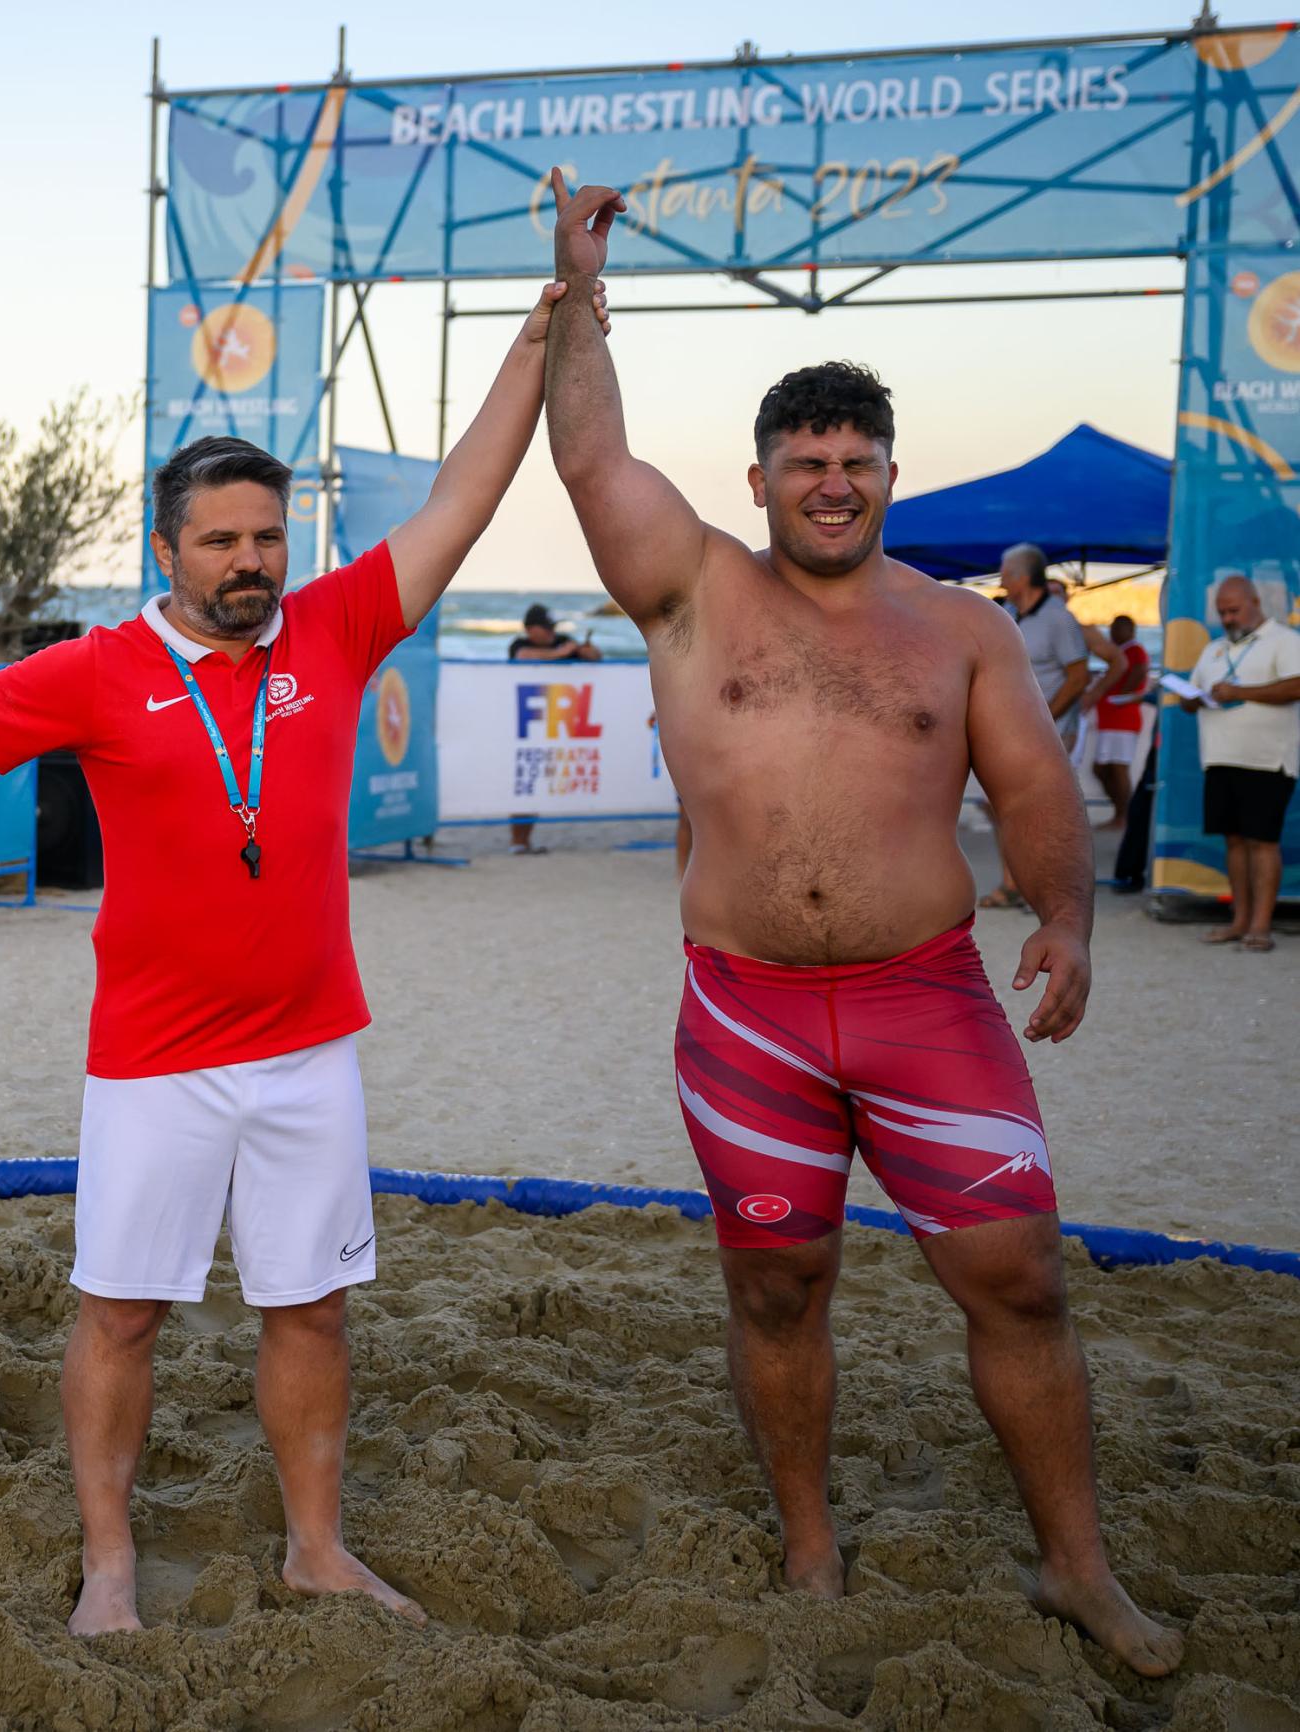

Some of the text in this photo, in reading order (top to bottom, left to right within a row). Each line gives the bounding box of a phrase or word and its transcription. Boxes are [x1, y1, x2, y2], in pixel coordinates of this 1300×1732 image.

[390, 65, 1129, 145] BEACH WRESTLING WORLD SERIES
[529, 153, 960, 243] Cstanta 2023
[516, 683, 602, 739] FRL
